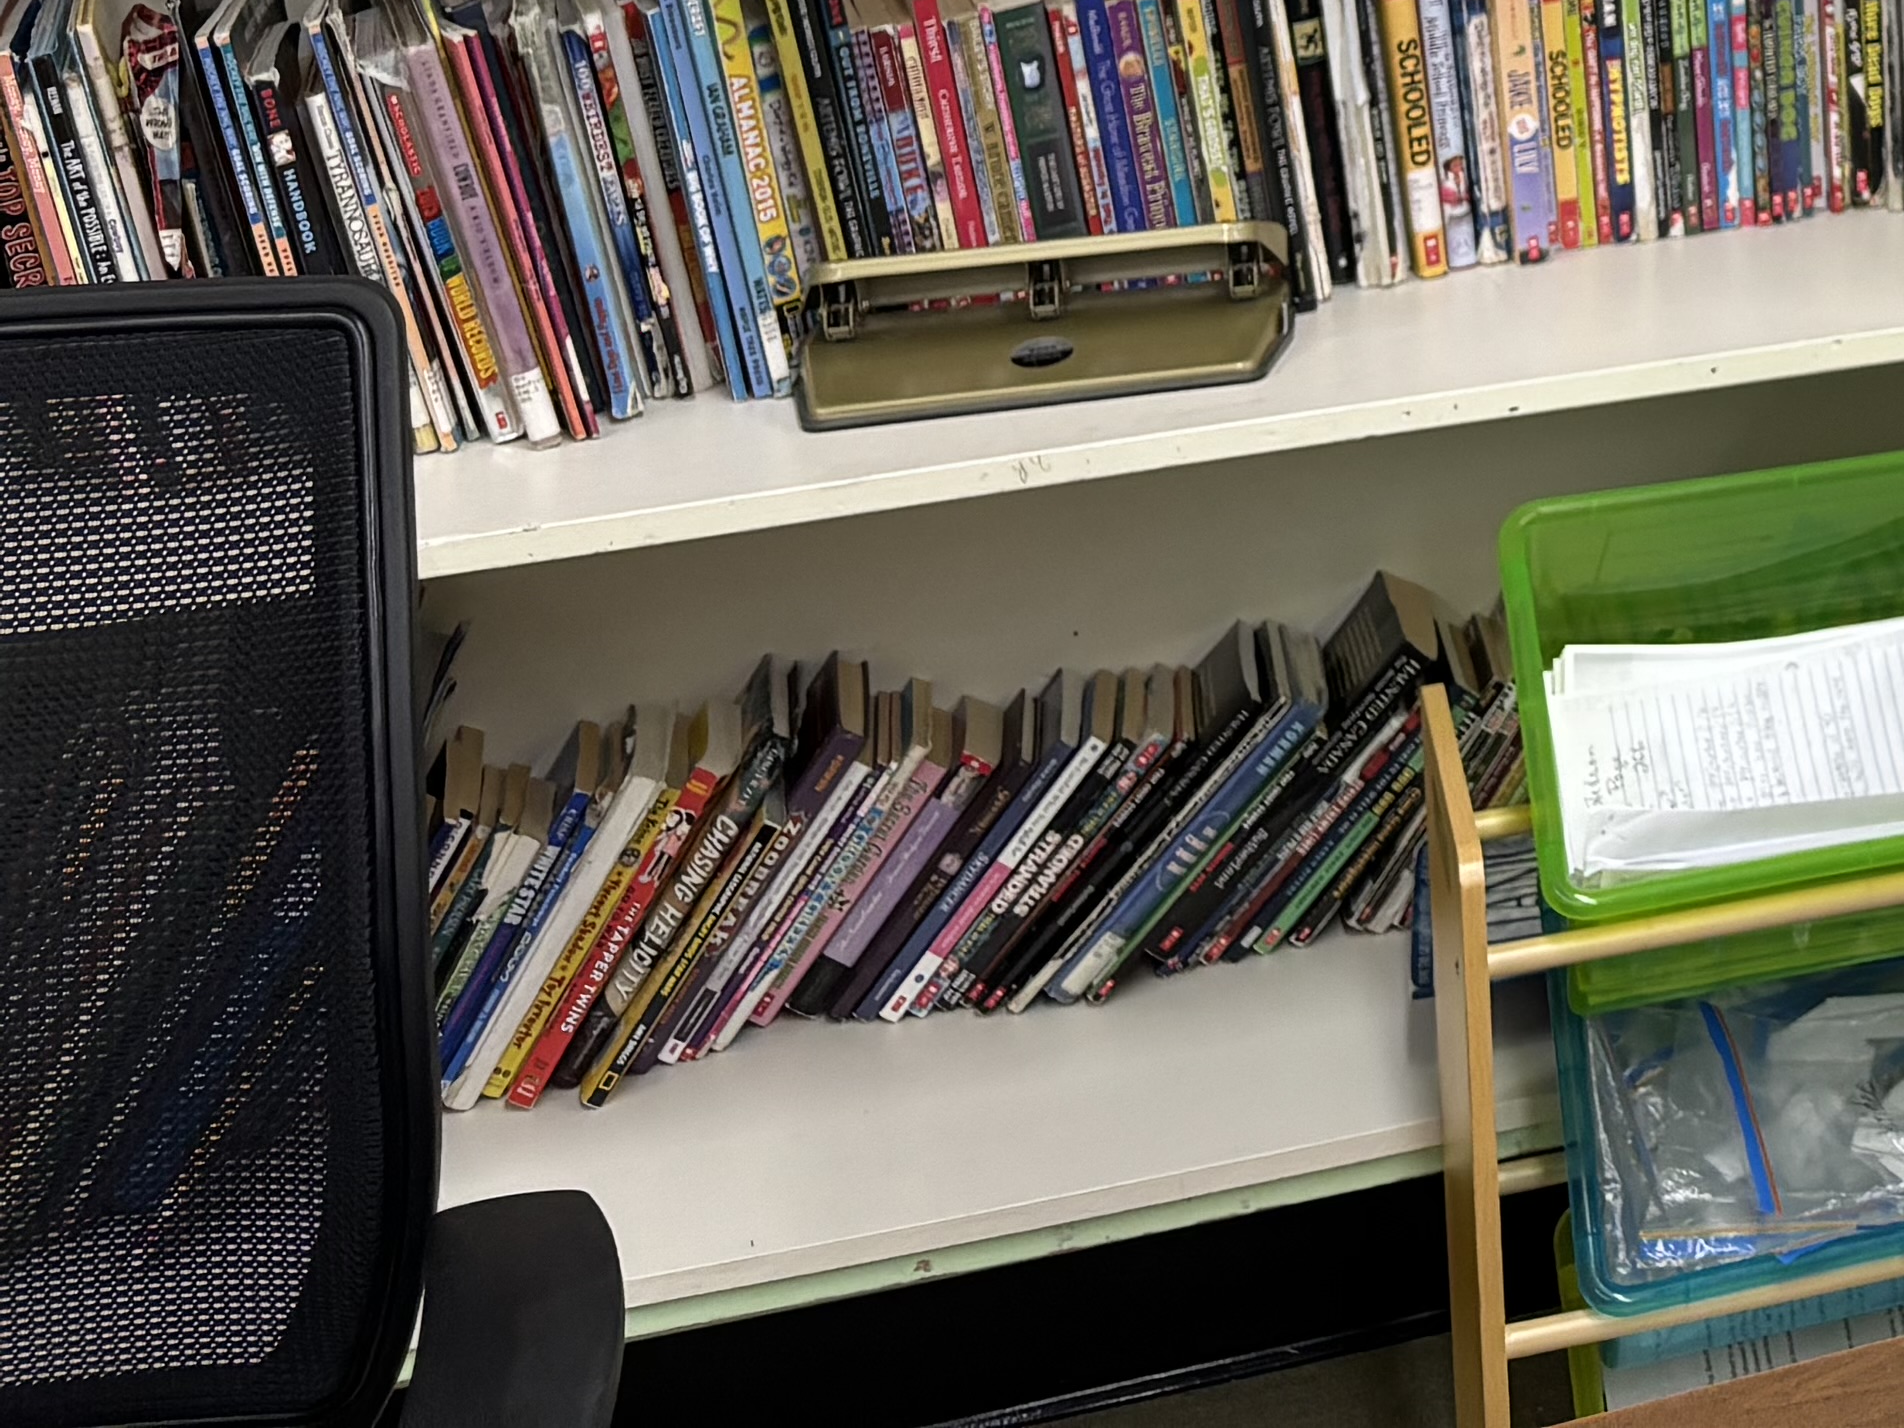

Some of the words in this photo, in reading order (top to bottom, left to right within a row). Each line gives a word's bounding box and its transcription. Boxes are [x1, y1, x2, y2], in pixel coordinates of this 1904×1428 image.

[1864, 0, 1879, 40] More
[838, 46, 854, 76] OUT
[1866, 43, 1880, 82] Dead
[704, 81, 721, 104] IAN
[844, 79, 864, 123] FROM
[1129, 82, 1147, 111] The
[1196, 74, 1214, 117] THAT'S
[1395, 37, 1432, 167] SCHOOLED
[1506, 68, 1532, 111] JAKE
[1547, 49, 1573, 150] SCHOOLED
[1867, 86, 1883, 127] Dogs
[59, 139, 77, 158] The
[390, 101, 421, 177] SCHOLASTIC
[710, 105, 734, 158] GRAHAM
[725, 72, 769, 172] ALMANAC
[748, 174, 779, 223] 2015
[25, 156, 46, 196] Money
[65, 156, 83, 181] ART
[230, 147, 246, 171] GOAL
[238, 171, 258, 214] SCORING
[256, 162, 271, 187] WITH
[259, 88, 280, 129] BONE
[281, 167, 316, 255] HANDBOOK
[344, 130, 359, 155] GOAL
[352, 154, 372, 197] SCORING
[1512, 142, 1538, 174] LILY
[0, 154, 26, 222] TOP
[72, 179, 86, 191] of
[75, 190, 91, 208] the
[263, 186, 282, 228] DEFENSE
[689, 192, 709, 227] BOOK
[79, 206, 106, 259] POSSIBLE:
[324, 147, 380, 282] TYRANNOSAUR
[2, 221, 48, 287] SECR
[96, 259, 111, 275] An
[445, 274, 475, 322] WORLD
[461, 318, 497, 381] RECORDS
[1360, 656, 1421, 725] HAUNTED
[1252, 718, 1305, 777] KORMAN
[1315, 717, 1370, 779] CANADA
[901, 774, 927, 801] The
[551, 806, 580, 841] CRISP
[870, 797, 911, 845] Secret
[522, 842, 561, 890] WHITE
[668, 811, 742, 907] CHASING
[839, 839, 884, 892] Garden
[937, 849, 990, 916] SKYDANCER
[988, 827, 1063, 916] STRANDED
[1011, 831, 1086, 920] STRANDED
[1210, 825, 1270, 891] Sutherland
[501, 886, 536, 929] STAR
[708, 816, 802, 951] ZOOBREAK
[622, 899, 642, 923] THE
[585, 921, 633, 984] TAPPER
[607, 900, 685, 1004] HELICITY
[542, 970, 567, 998] Toy
[556, 981, 598, 1035] TWINS
